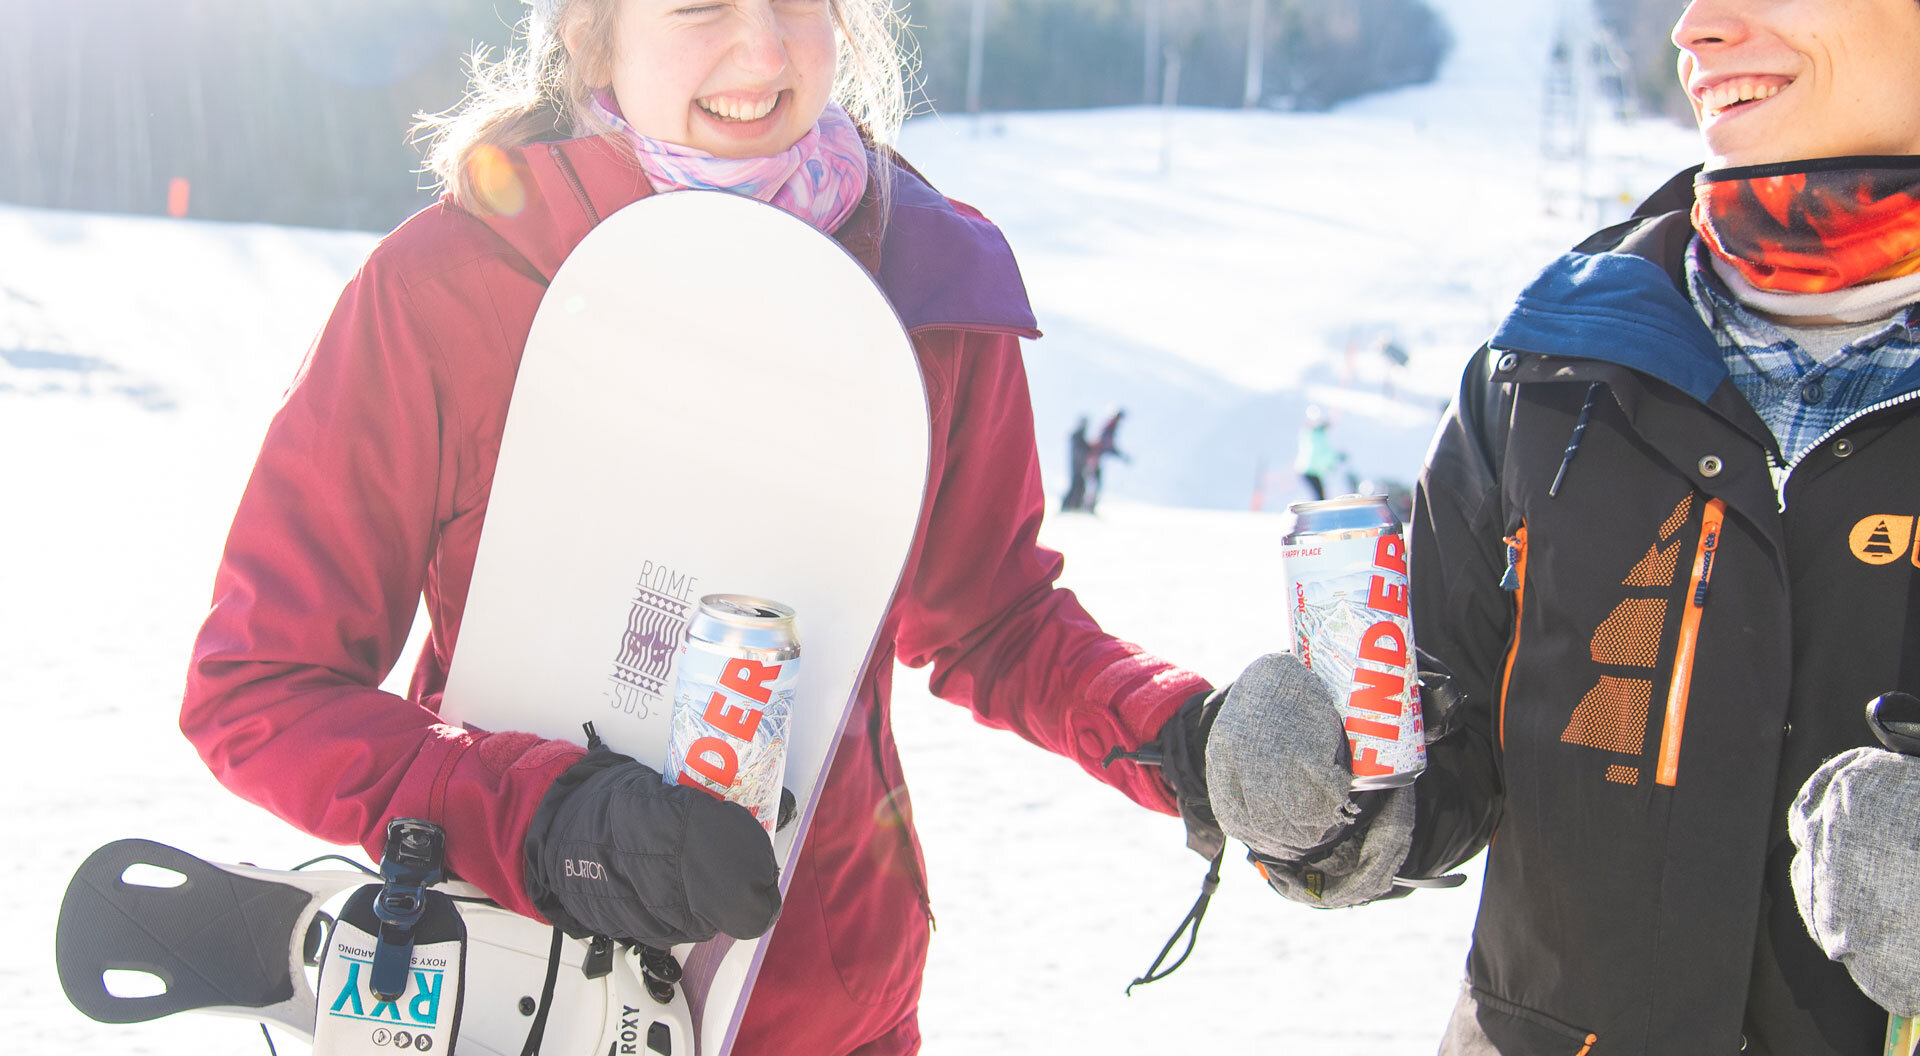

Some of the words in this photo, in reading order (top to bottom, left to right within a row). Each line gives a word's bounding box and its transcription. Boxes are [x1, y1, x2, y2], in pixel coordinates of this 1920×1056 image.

[1301, 547, 1322, 557] PLACE
[638, 559, 698, 602] ROME
[1296, 581, 1306, 613] JUICY
[1344, 533, 1408, 777] FINDER
[565, 859, 608, 881] BURTON
[420, 958, 447, 967] ROXY
[620, 1004, 640, 1054] ROXY
